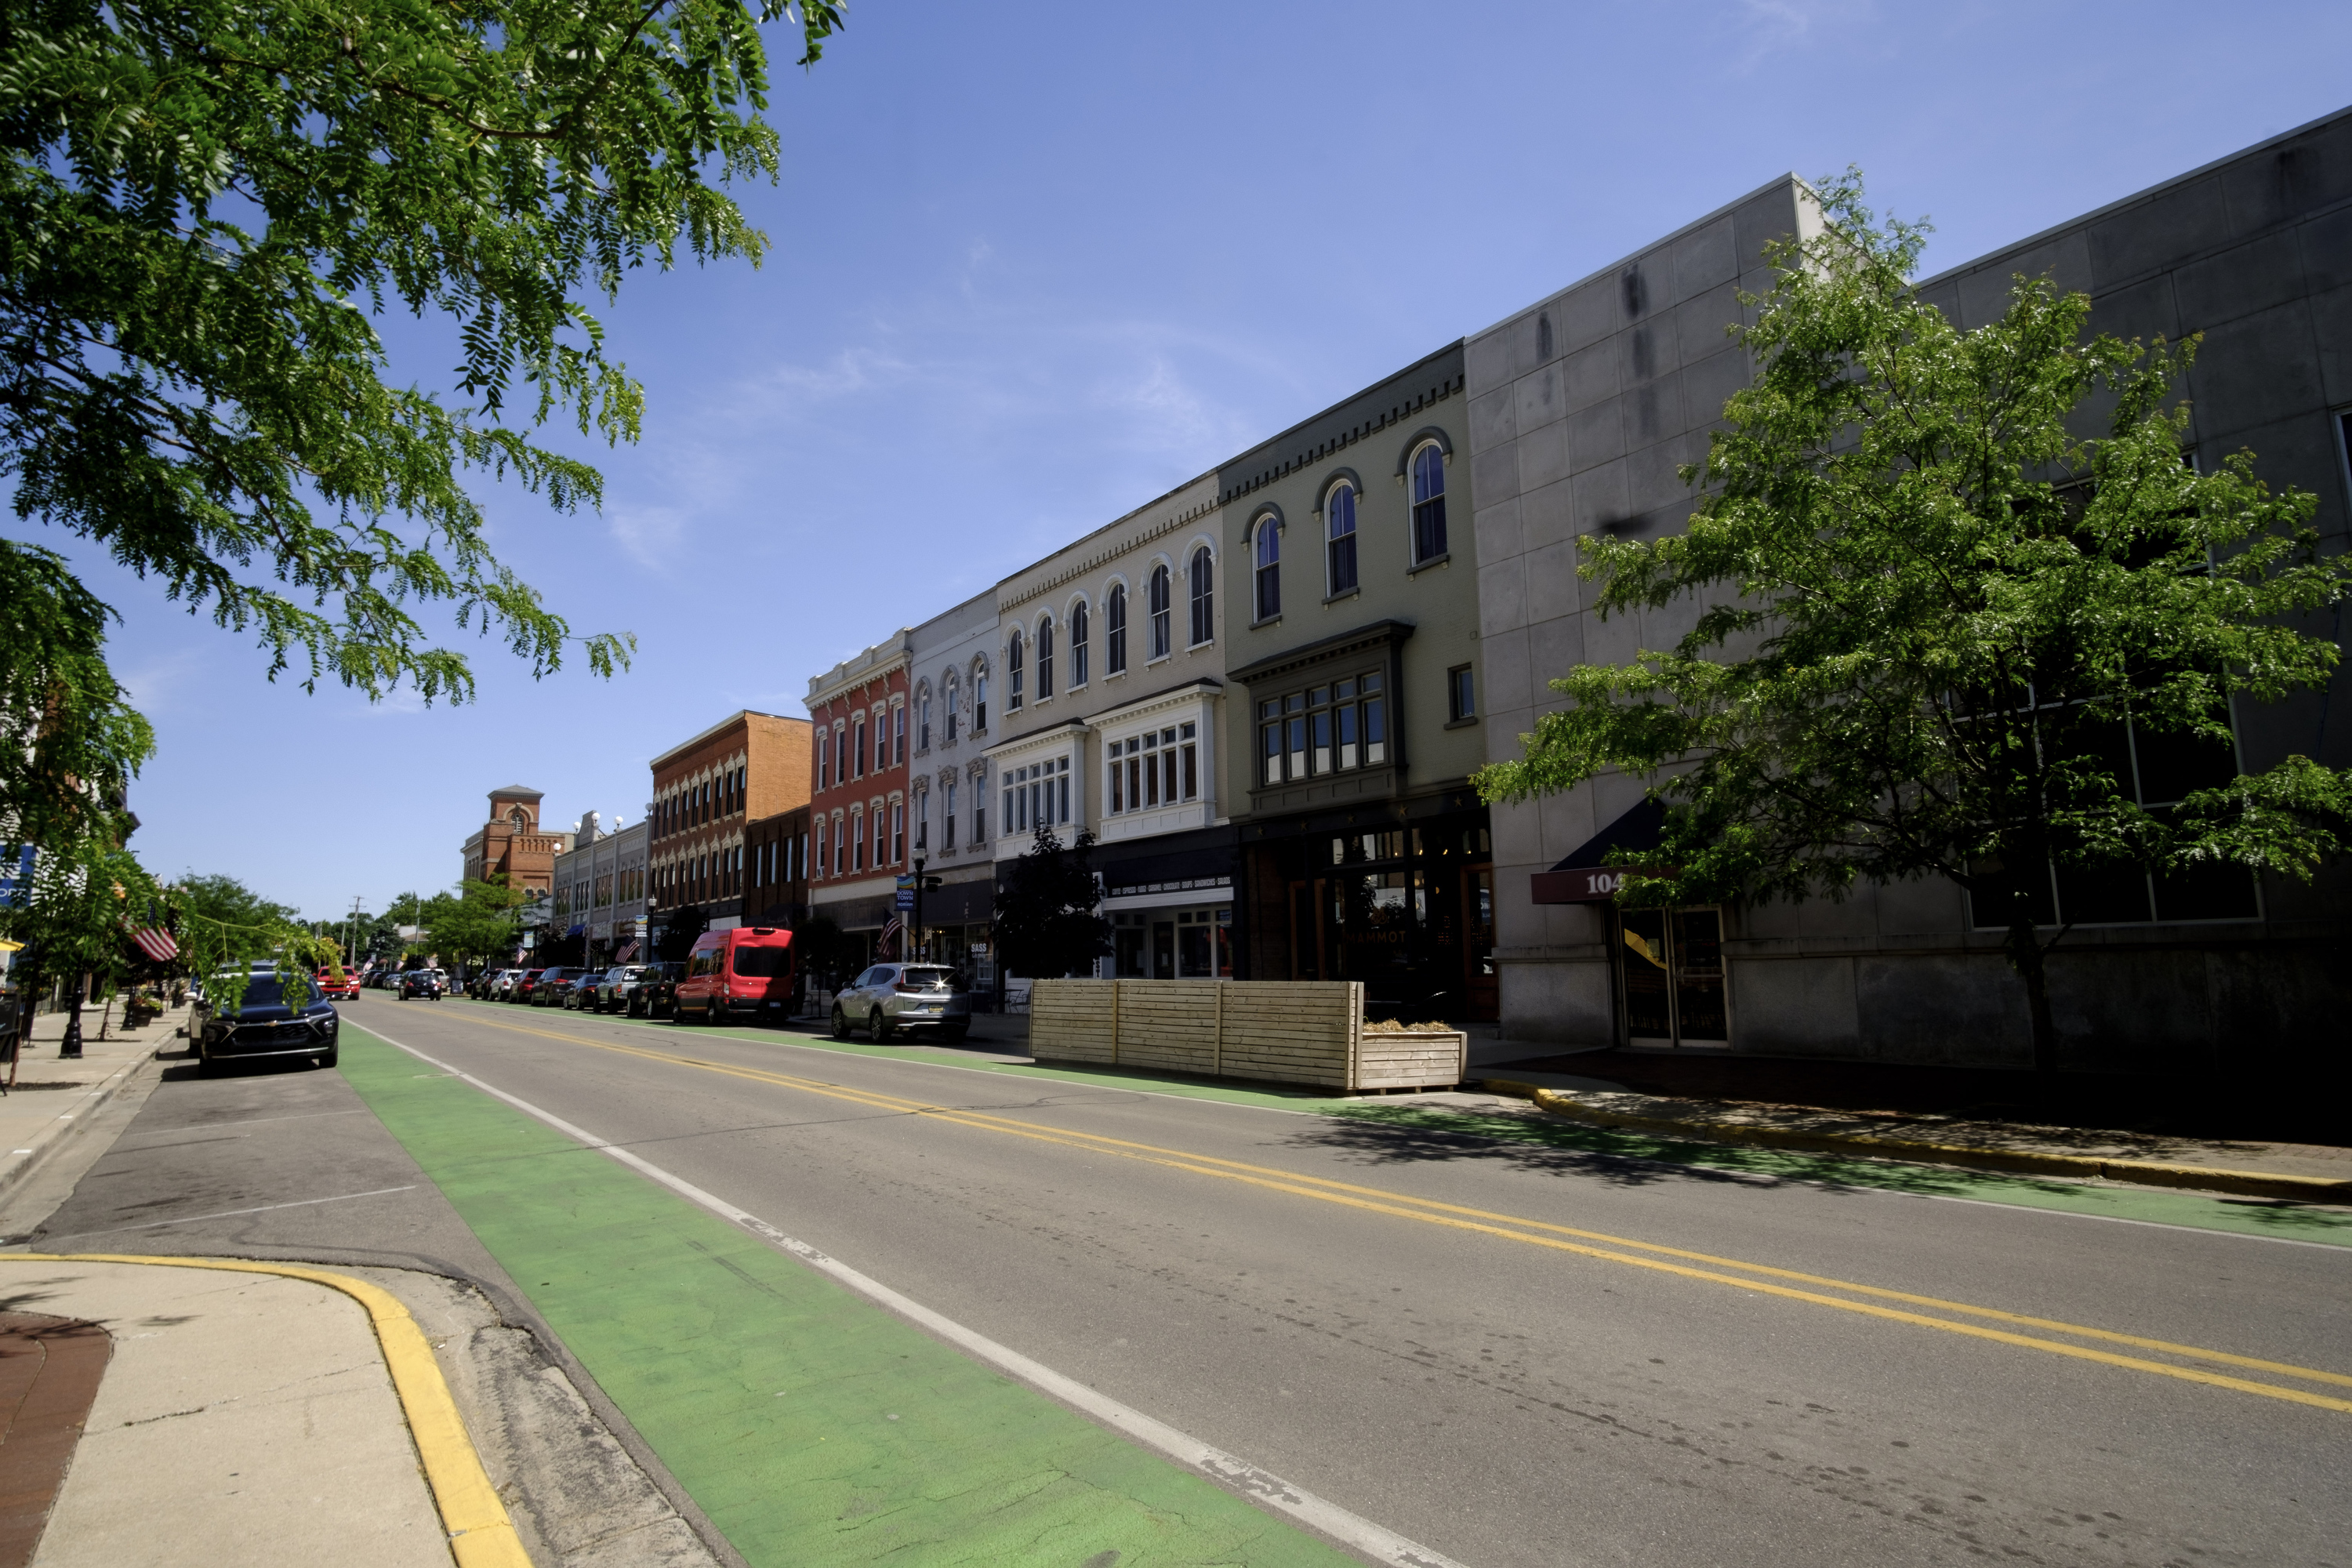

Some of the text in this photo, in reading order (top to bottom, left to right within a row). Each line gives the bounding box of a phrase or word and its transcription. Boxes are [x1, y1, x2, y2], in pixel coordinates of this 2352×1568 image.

[1163, 881, 1180, 891] CHOCOLATE
[1182, 880, 1192, 889] SOUPS
[1194, 878, 1215, 887] SANDWICHES
[1217, 877, 1231, 885] SALADS
[1586, 872, 1625, 894] 104
[971, 943, 987, 953] SASS
